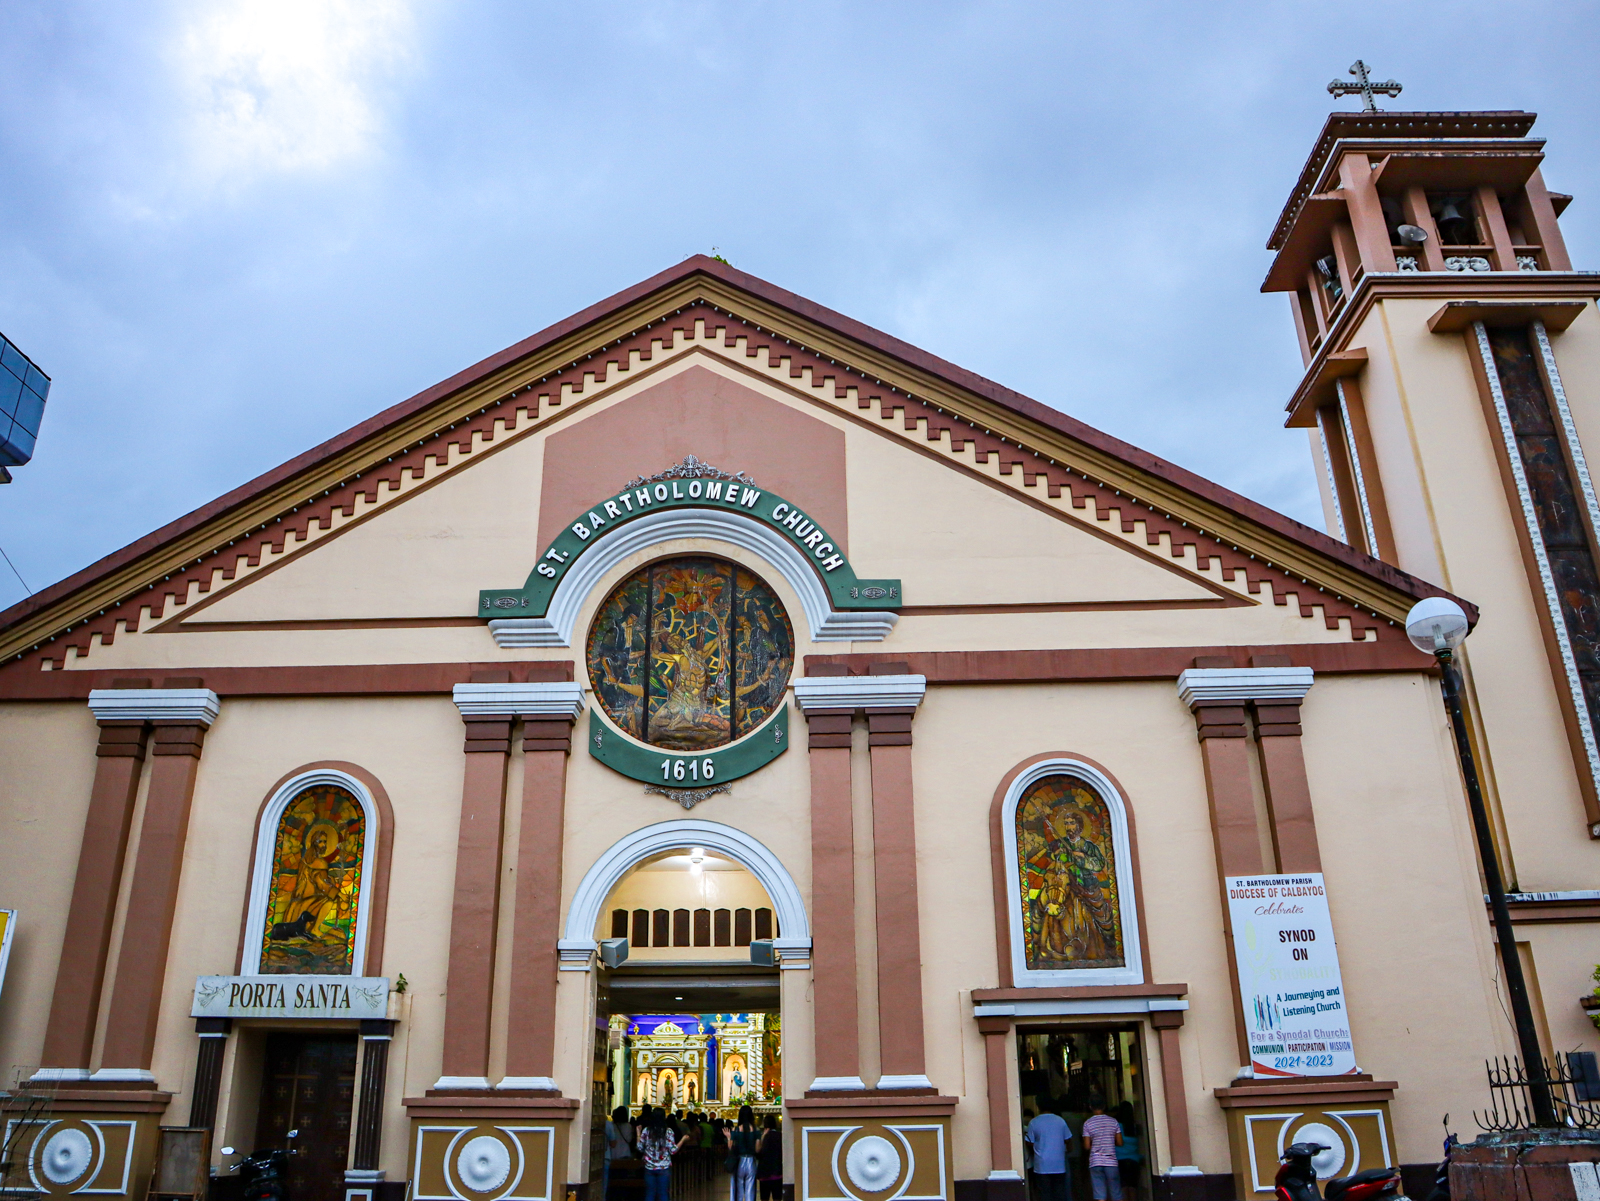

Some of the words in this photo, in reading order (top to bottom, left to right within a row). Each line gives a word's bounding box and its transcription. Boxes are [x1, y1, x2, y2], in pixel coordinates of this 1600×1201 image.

[537, 548, 569, 579] ST.
[572, 480, 761, 541] BARTHOLOMEW
[771, 502, 845, 573] CHURCH
[661, 758, 715, 781] 1616
[1246, 879, 1290, 887] BARTHOLOMEW
[1230, 888, 1266, 899] DIOCESE
[1268, 887, 1278, 898] OF
[1281, 886, 1324, 897] CALBAYOG
[1254, 902, 1304, 915] Celebrates
[1279, 929, 1316, 943] SYNOD
[1292, 948, 1308, 961] ON
[228, 983, 286, 1008] PORTA
[294, 983, 351, 1009] SANTA
[1276, 994, 1282, 1002] A
[1284, 989, 1325, 1002] Journeying
[1326, 986, 1340, 996] and
[1283, 1005, 1316, 1017] Listening
[1316, 1001, 1341, 1012] Church
[1250, 1031, 1266, 1042] For
[1268, 1032, 1274, 1040] a
[1276, 1029, 1311, 1042] Synodal
[1313, 1028, 1349, 1039] Church:
[1252, 1044, 1284, 1055] COMMUNION
[1288, 1042, 1326, 1053] PARTICIPATION
[1329, 1041, 1351, 1051] MISSION
[1274, 1054, 1333, 1069] 2021-2023
